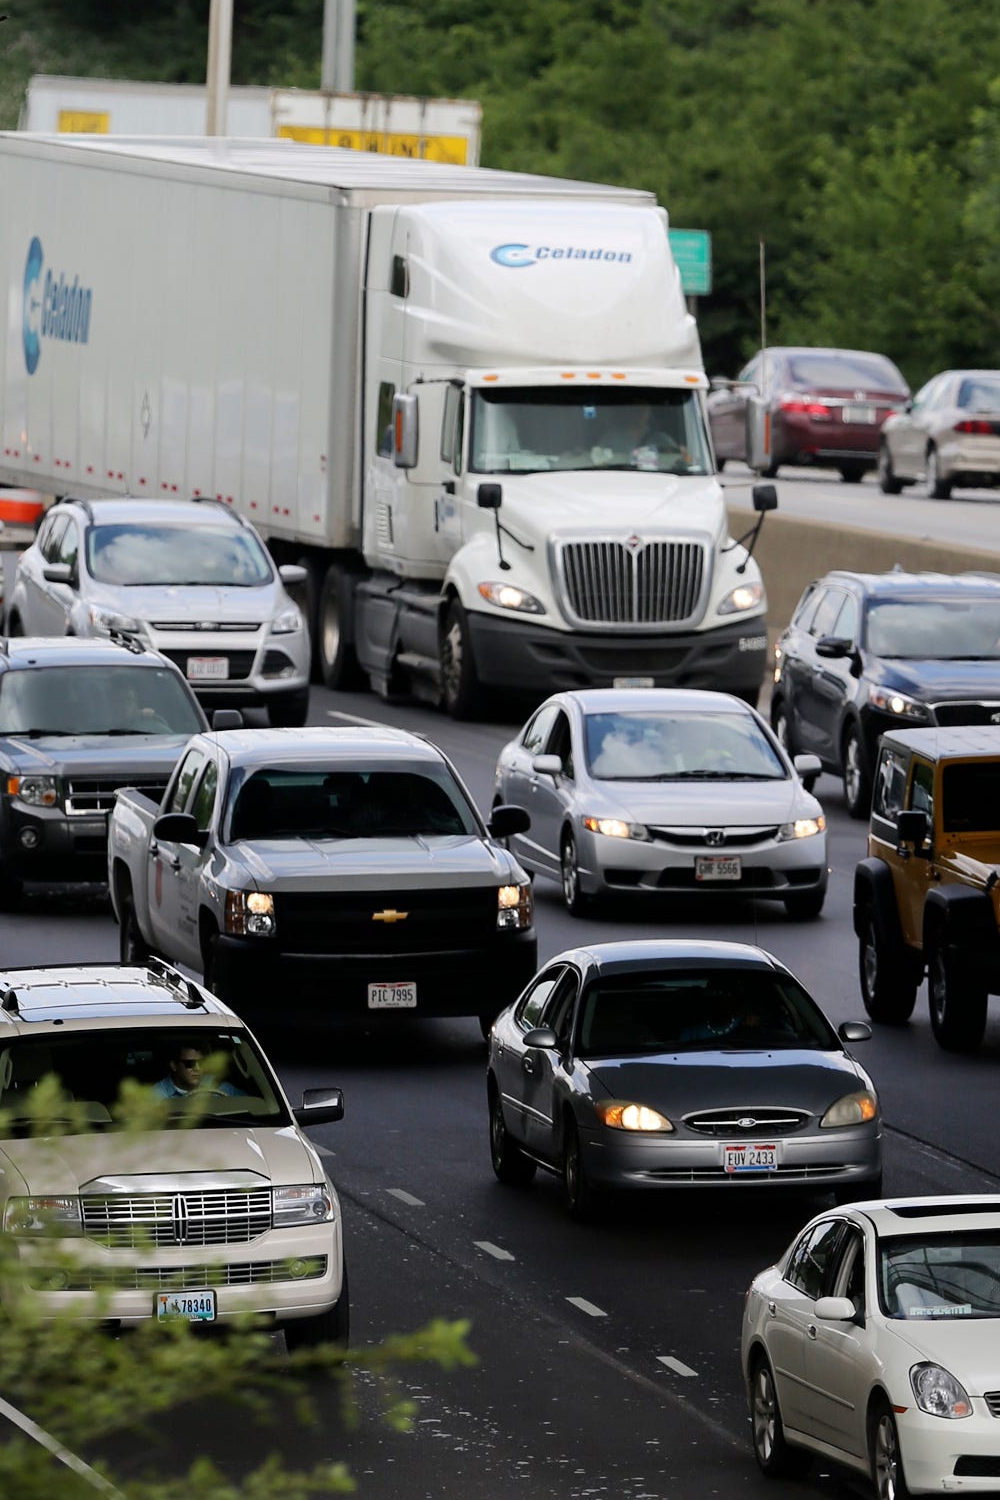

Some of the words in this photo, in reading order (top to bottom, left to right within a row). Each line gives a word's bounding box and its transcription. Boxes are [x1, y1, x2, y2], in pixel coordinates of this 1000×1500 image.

[535, 246, 633, 263] Celadon
[371, 989, 388, 1002] PIC
[390, 989, 414, 1002] 7995
[749, 1151, 774, 1165] 2433
[181, 1298, 211, 1313] 78340
